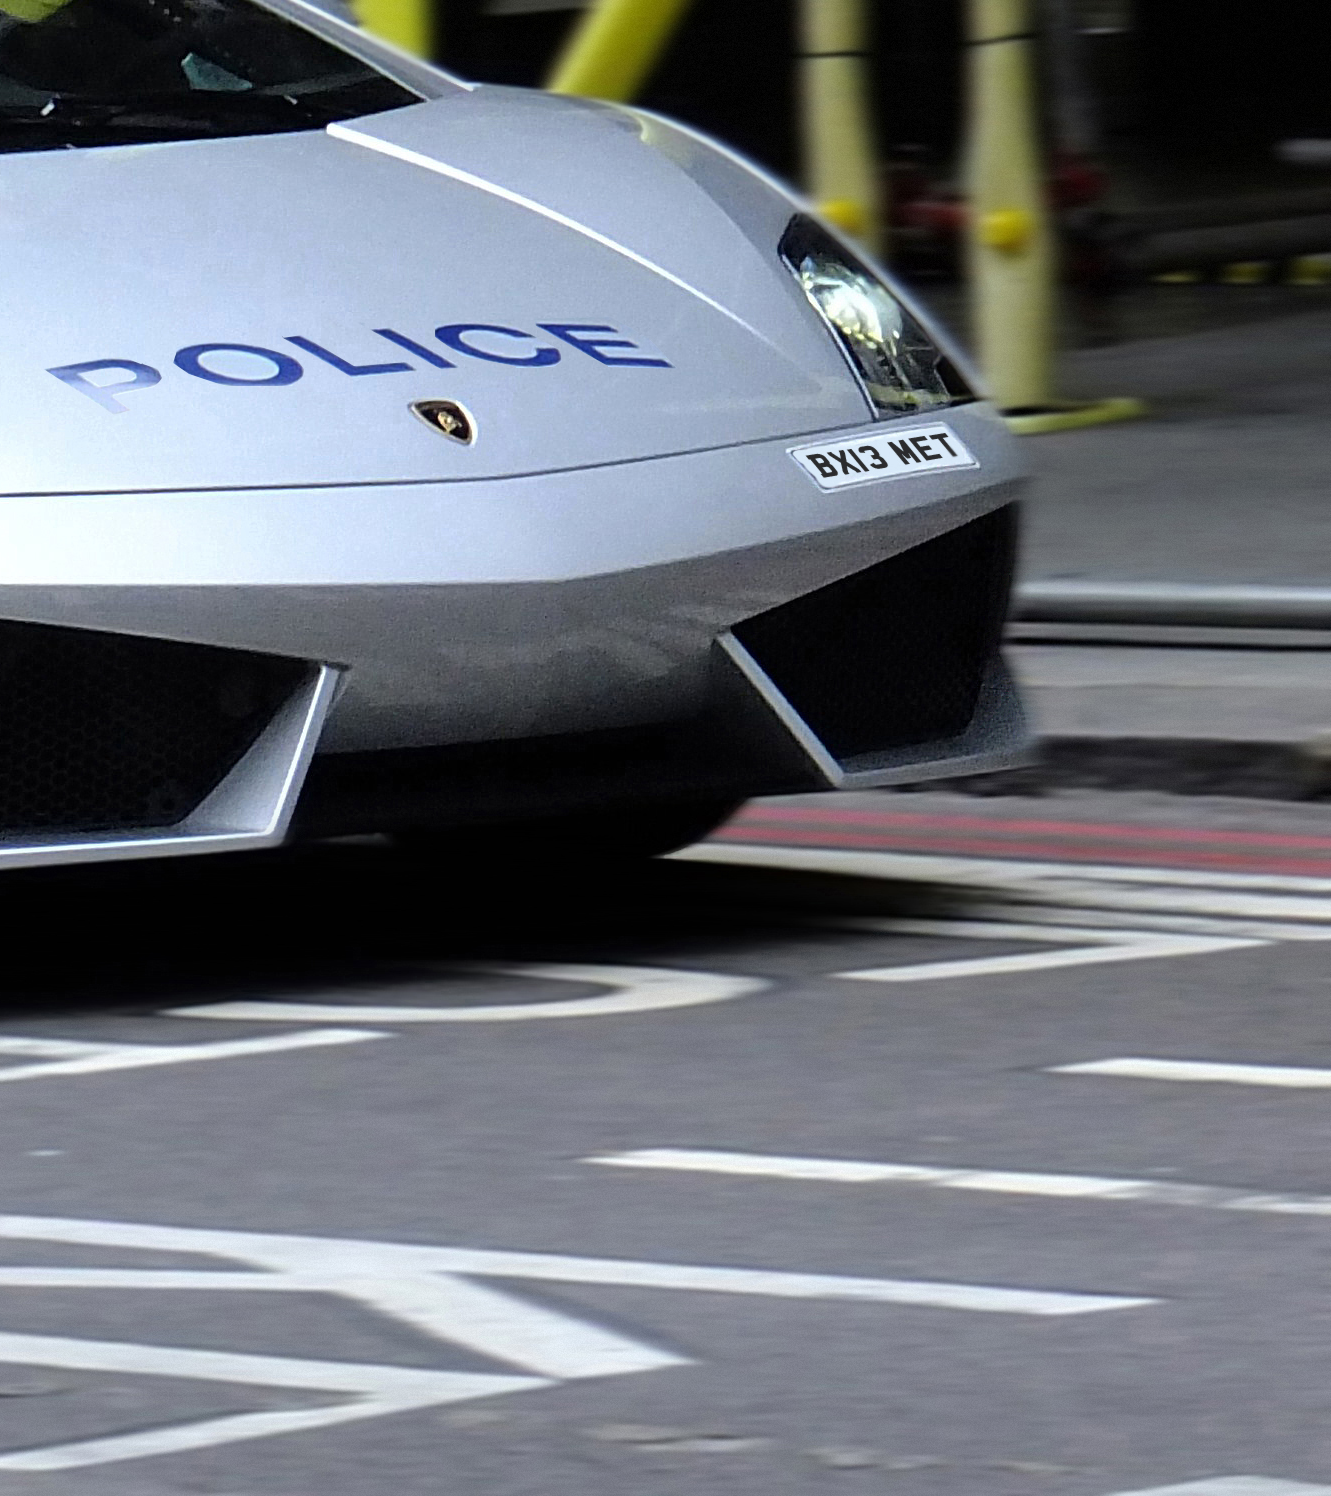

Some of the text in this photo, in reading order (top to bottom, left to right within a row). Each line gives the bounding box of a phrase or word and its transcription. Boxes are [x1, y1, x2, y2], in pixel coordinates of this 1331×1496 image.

[46, 323, 674, 414] POLICE
[806, 433, 958, 478] BX13 MET
